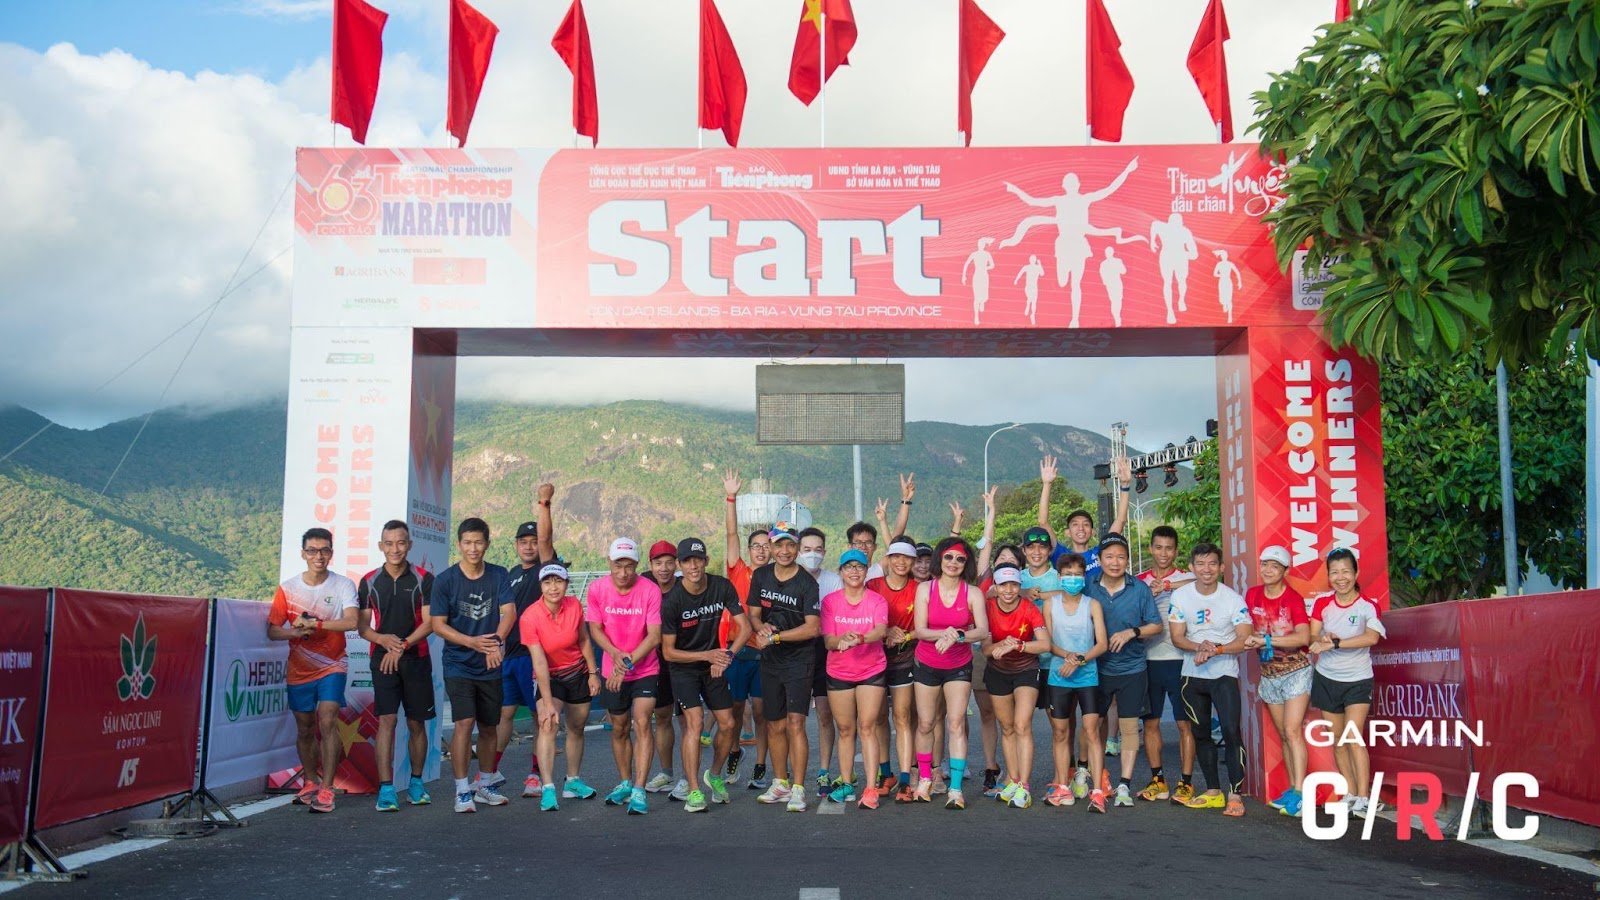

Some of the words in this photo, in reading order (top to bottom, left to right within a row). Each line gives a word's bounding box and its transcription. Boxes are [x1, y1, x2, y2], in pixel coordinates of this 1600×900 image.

[447, 166, 513, 174] CHAMPIONSHIP
[677, 166, 696, 175] THAO
[828, 165, 849, 175] UBND
[688, 179, 707, 188] NAM
[921, 178, 940, 187] THAO
[1167, 167, 1206, 194] Theo
[1197, 195, 1226, 212] chân
[382, 202, 512, 237] MARATHON
[588, 199, 941, 297] Start
[622, 305, 654, 316] DAO
[656, 305, 721, 316] ISLANDS
[731, 305, 752, 316] BA
[755, 305, 778, 316] RIA
[789, 305, 833, 316] VUNG
[835, 305, 865, 316] TAU
[867, 305, 942, 316] PROVINCE
[1284, 360, 1319, 567] WELCOME
[412, 513, 447, 533] MARATHON
[760, 589, 797, 606] GARMIN
[605, 606, 642, 615] GARMIN
[682, 602, 724, 619] GARMIN
[834, 616, 873, 624] GARMIN
[3, 649, 17, 673] VIỆT
[18, 651, 33, 669] NAM
[1377, 683, 1463, 719] AGRIBANK
[102, 711, 119, 734] SÂM
[120, 712, 143, 734] NGỌC
[143, 710, 162, 728] LINH
